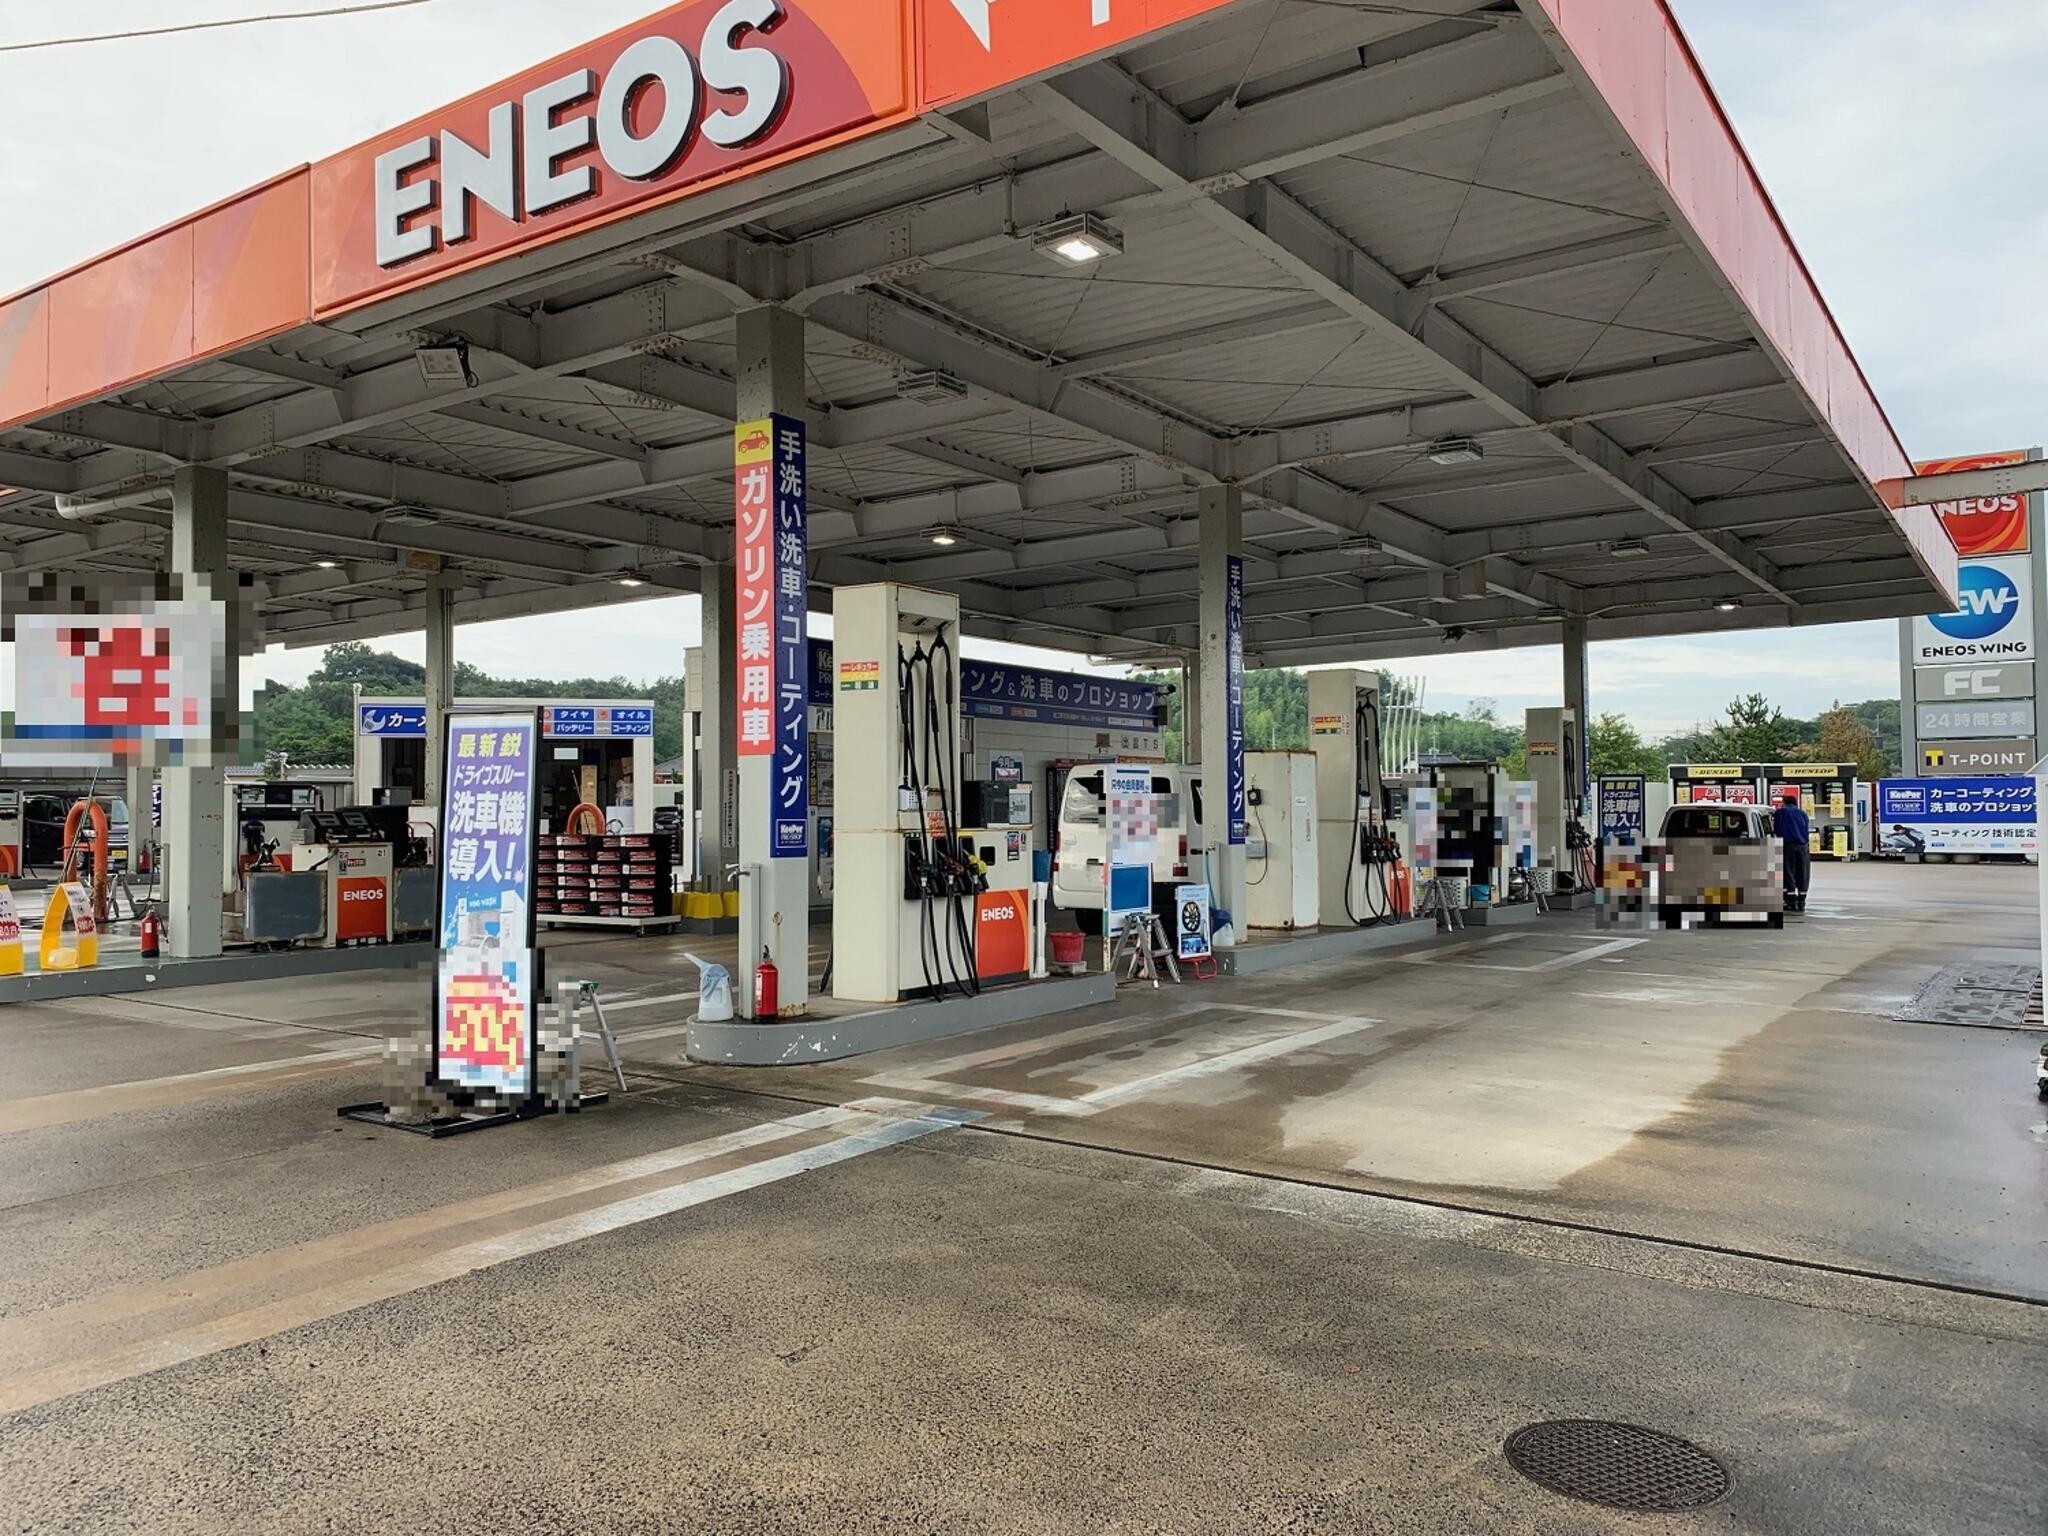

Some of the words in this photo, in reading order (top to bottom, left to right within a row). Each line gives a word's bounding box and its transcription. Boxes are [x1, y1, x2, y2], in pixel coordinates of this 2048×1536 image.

[374, 0, 790, 267] ENEOS
[1936, 494, 2018, 518] NEOS
[741, 466, 771, 746] ガソリン乗用車
[779, 429, 803, 808] 手洗い洗車・コーティング
[1922, 644, 1976, 658] ENEOS
[1980, 641, 2027, 655] WING
[961, 669, 1156, 711] ング&洗車のプロショップ
[1944, 668, 2002, 696] FC
[559, 709, 590, 720] タイヤ
[616, 709, 646, 720] オイル
[1924, 710, 2028, 730] 24時間営業
[555, 723, 593, 733] バッテリー
[612, 724, 650, 733] コーティング
[456, 732, 522, 759] 最新鋭
[1949, 752, 2027, 767] T-POINT
[453, 764, 526, 787] ドライブスルー
[1698, 768, 1739, 776] DUNLOP
[1930, 787, 2036, 799] カーコーティング
[449, 790, 526, 837] 洗車機
[343, 888, 384, 901] ENEOS
[981, 905, 1015, 922] ENEOS
